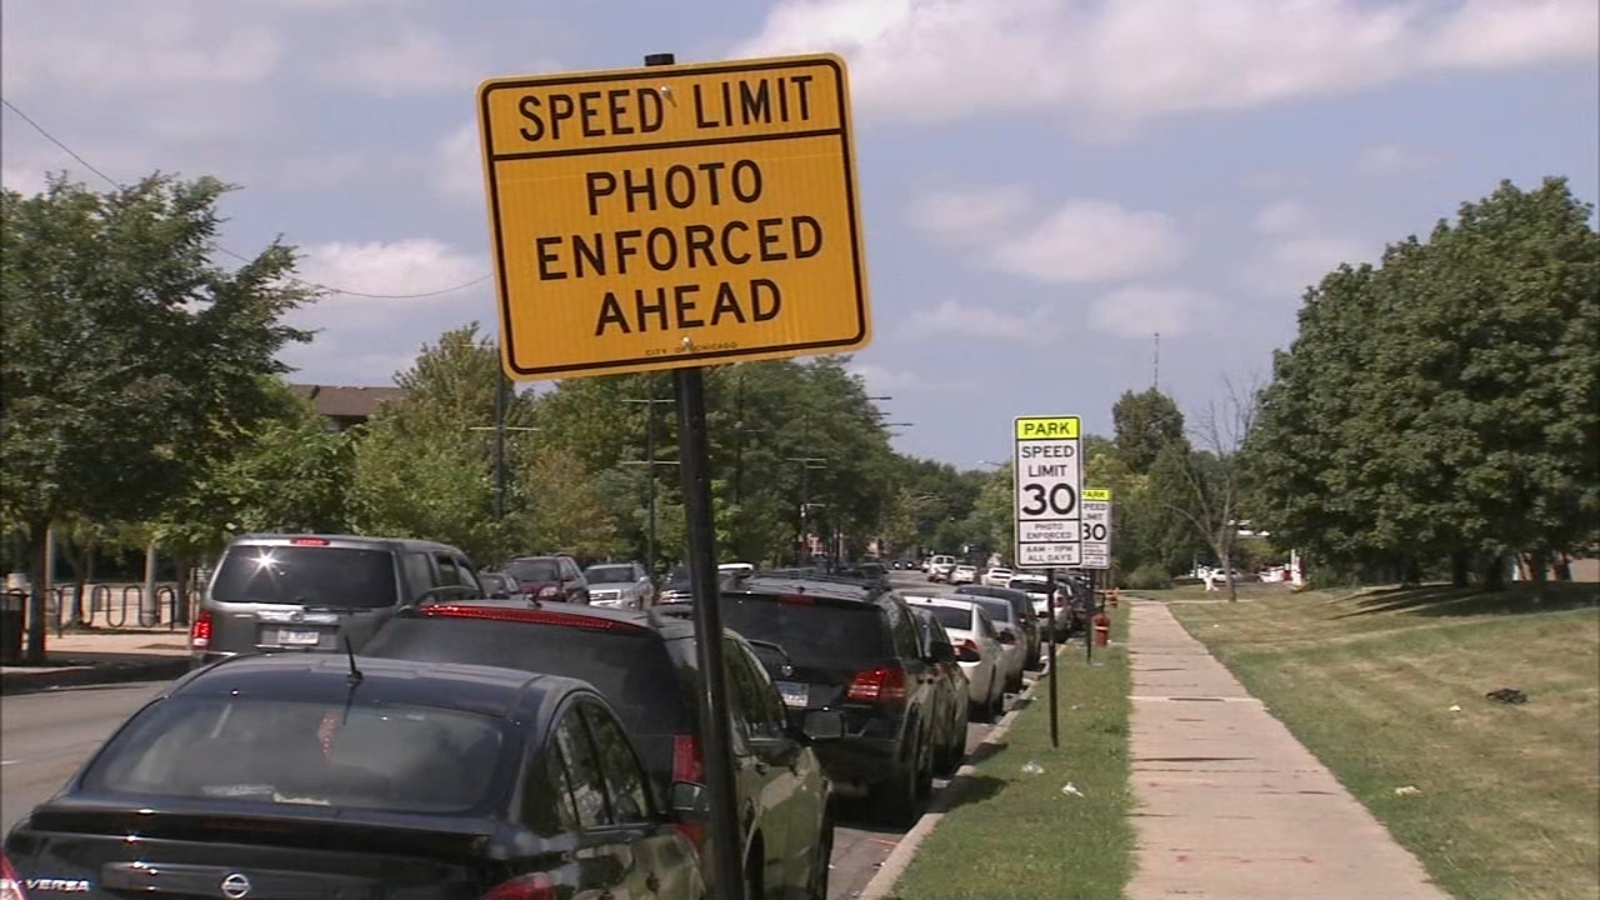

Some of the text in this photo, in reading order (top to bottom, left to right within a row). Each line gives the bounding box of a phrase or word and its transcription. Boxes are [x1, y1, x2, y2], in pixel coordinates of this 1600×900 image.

[519, 75, 813, 141] SPEED LIMIT
[586, 159, 762, 215] PHOTO
[536, 216, 822, 280] ENFORCED
[595, 279, 781, 336] AHEAD
[645, 348, 667, 356] CITY
[1024, 421, 1071, 435] PARK
[1021, 445, 1075, 458] SPEED
[1028, 464, 1068, 477] LIMIT
[1022, 483, 1076, 515] 30
[1034, 523, 1064, 531] PHOTO
[1083, 523, 1106, 541] 30
[1026, 531, 1072, 540] ENFORCED
[26, 879, 90, 892] VERSA
